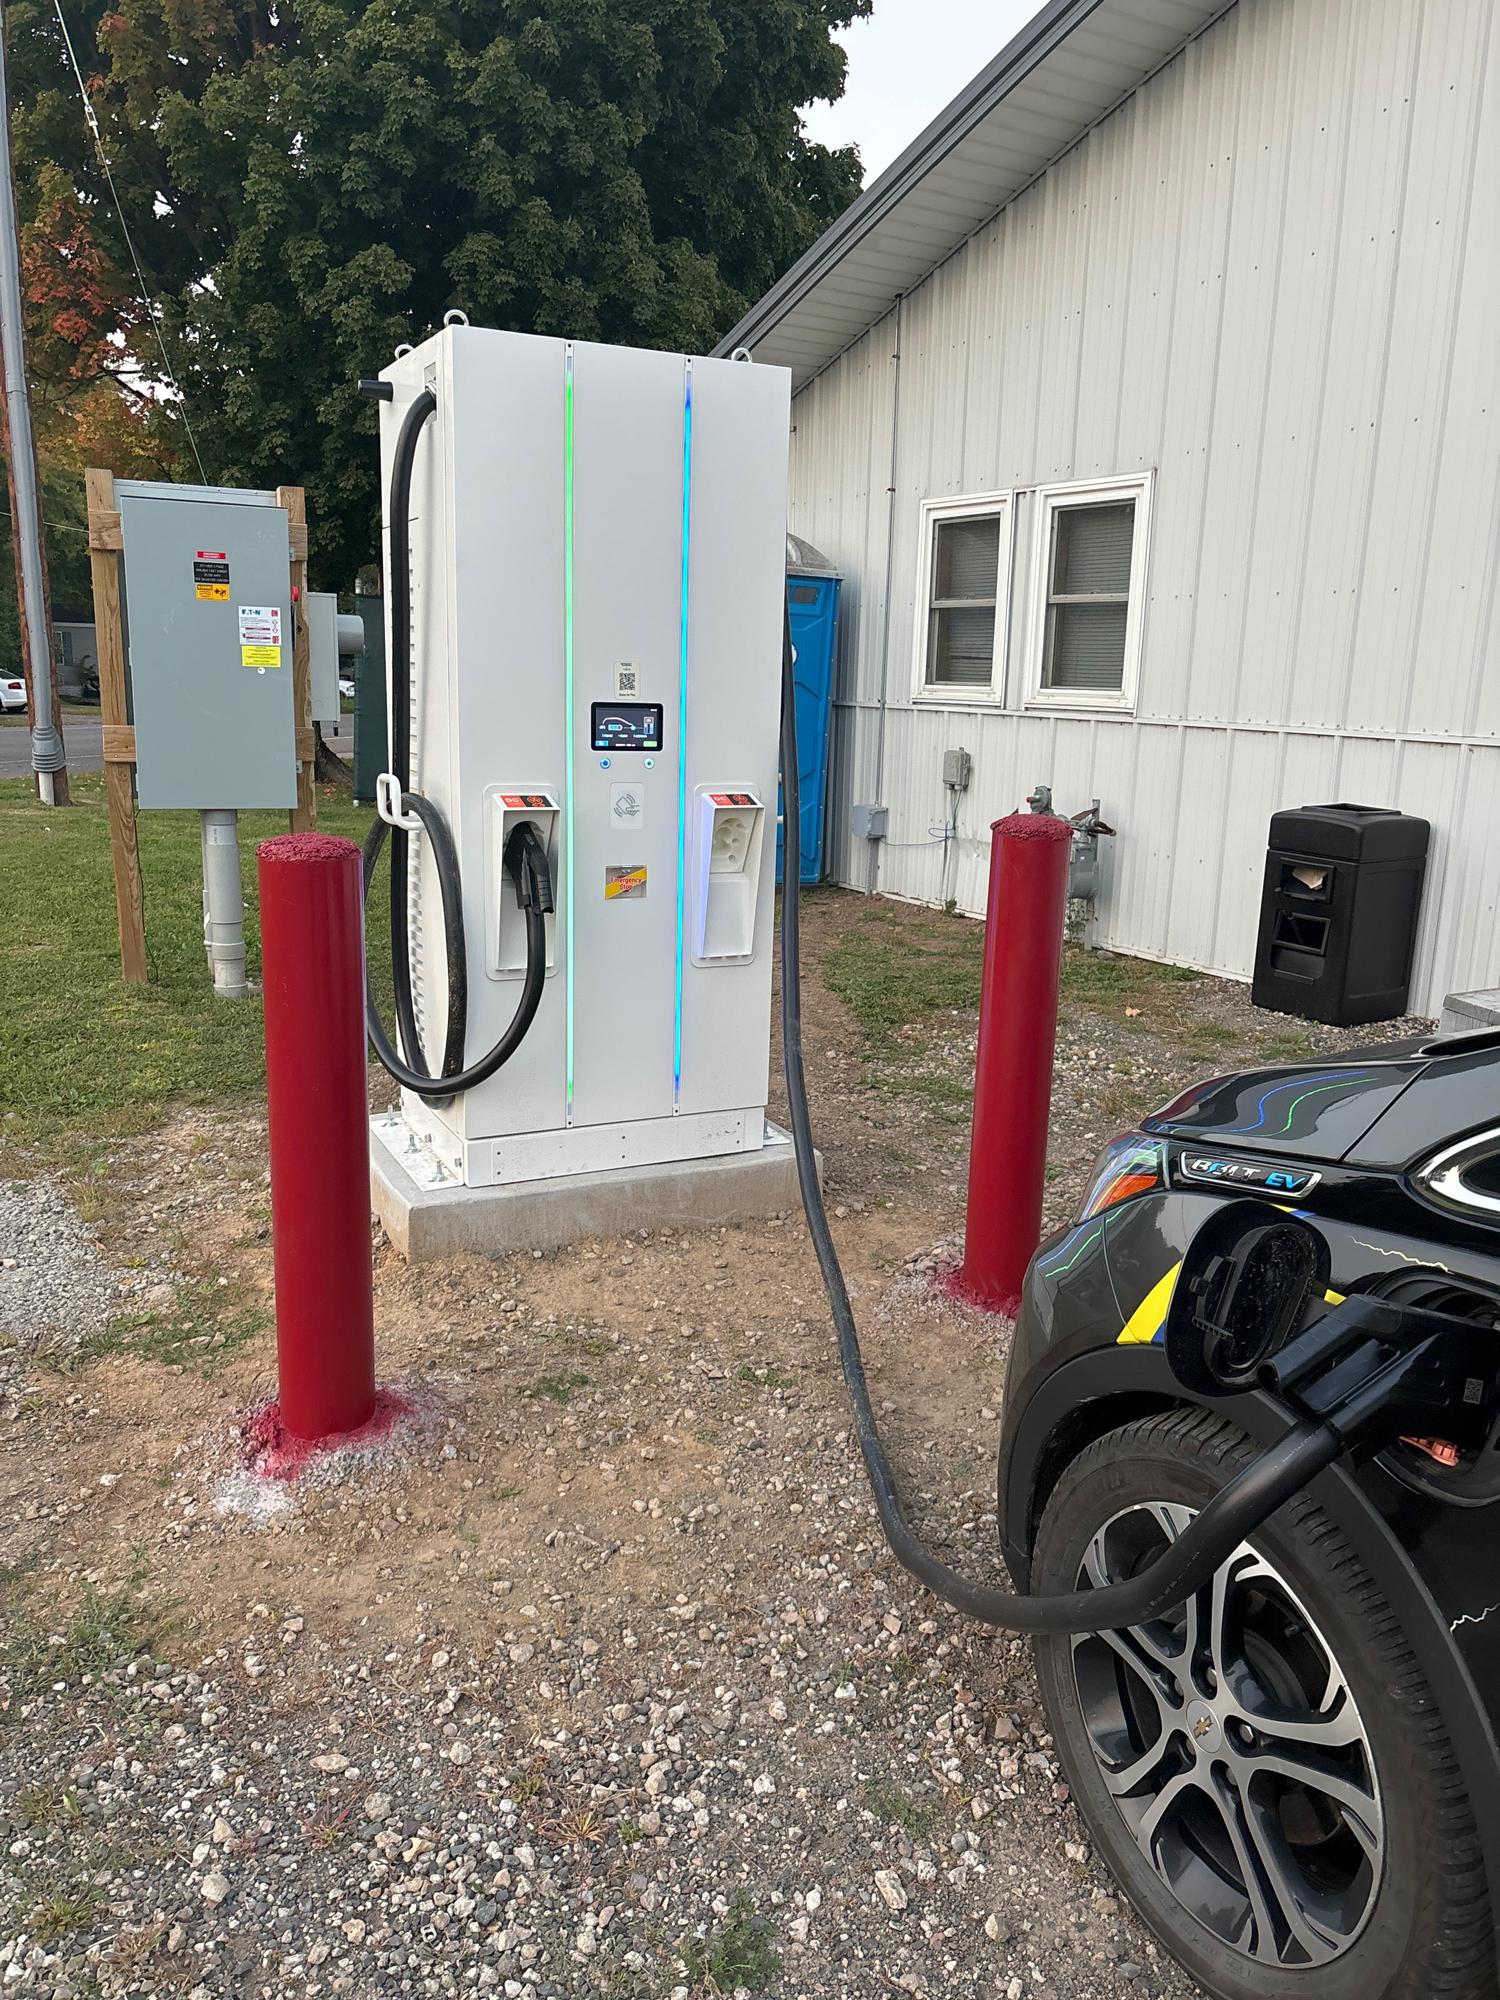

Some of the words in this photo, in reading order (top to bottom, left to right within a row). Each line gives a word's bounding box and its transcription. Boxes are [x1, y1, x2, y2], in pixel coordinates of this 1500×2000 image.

[610, 877, 642, 885] Emergency
[1191, 1159, 1261, 1180] BOLT
[1265, 1171, 1306, 1189] EV
